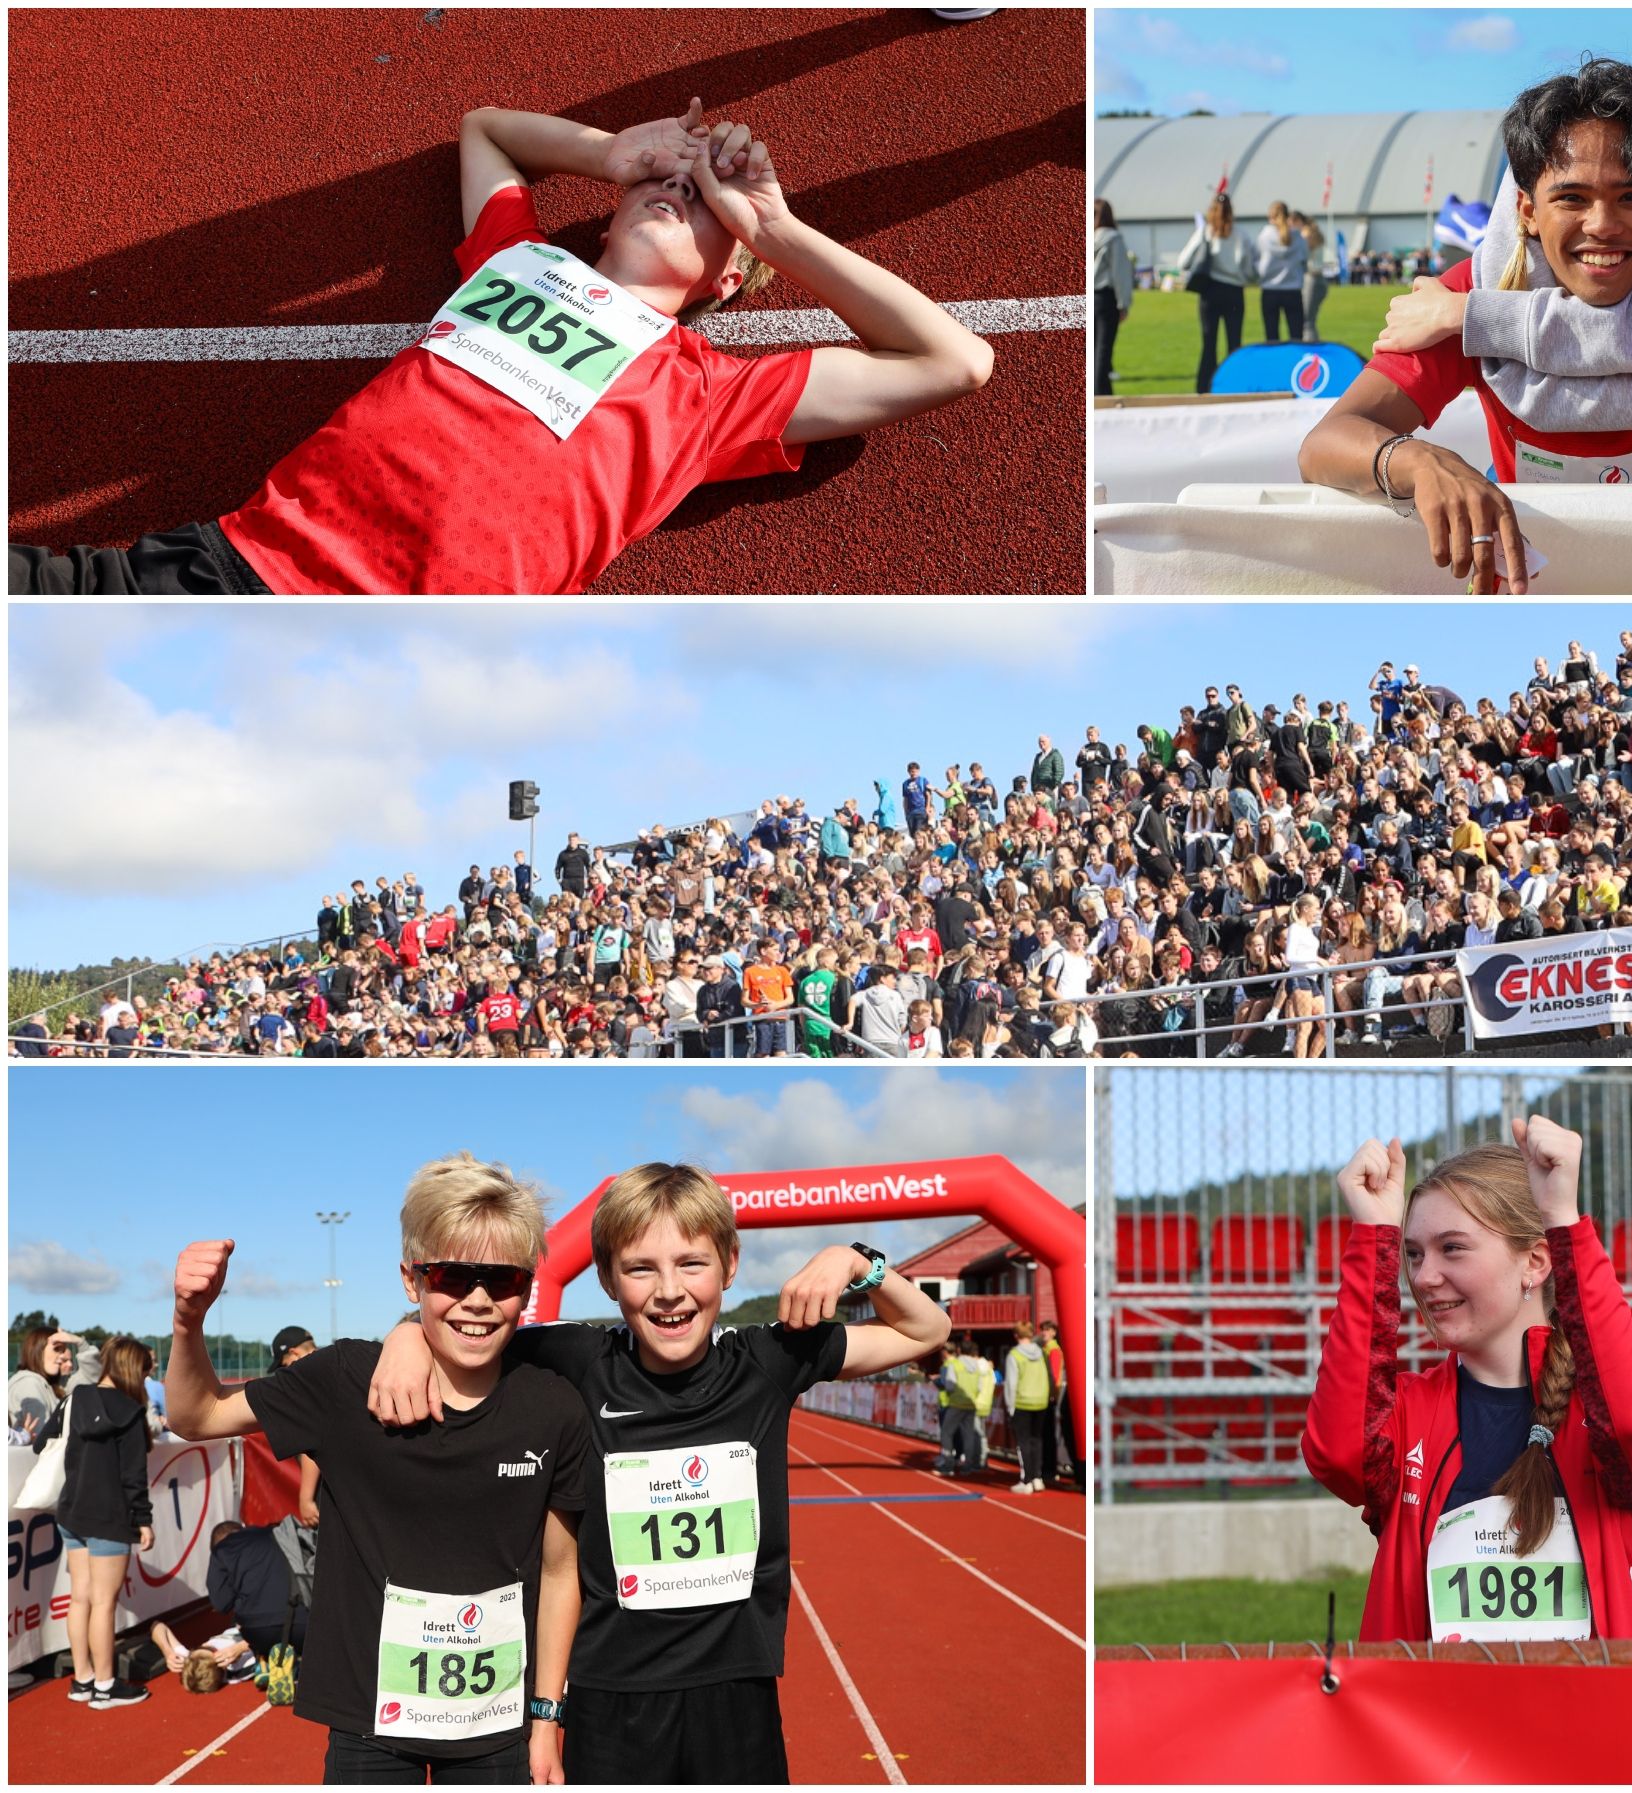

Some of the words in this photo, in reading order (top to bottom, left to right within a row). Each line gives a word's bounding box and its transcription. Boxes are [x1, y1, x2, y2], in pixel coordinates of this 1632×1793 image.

[543, 270, 578, 292] Idrett
[534, 278, 557, 294] Uten
[556, 292, 595, 315] Alkohol
[460, 279, 617, 373] 2057
[451, 332, 583, 420] SparebankenVest
[1532, 950, 1582, 965] AUTORISERT
[1530, 993, 1618, 1014] KAROSSERI
[729, 1449, 750, 1459] 2023
[498, 1462, 536, 1477] PUMA
[649, 1479, 682, 1491] Idrett
[650, 1495, 673, 1504] Uten
[674, 1490, 710, 1502] Alkohol
[640, 1507, 725, 1561] 131
[1474, 1530, 1508, 1541] Idrett
[1476, 1545, 1498, 1554] Uten
[499, 1591, 516, 1603] 2023
[1447, 1565, 1564, 1619] 1981
[423, 1621, 456, 1632] Idrett
[422, 1635, 445, 1644] Uten
[446, 1635, 481, 1645] Alkohol
[410, 1650, 496, 1697] 185
[406, 1701, 519, 1724] SparebankenVest
